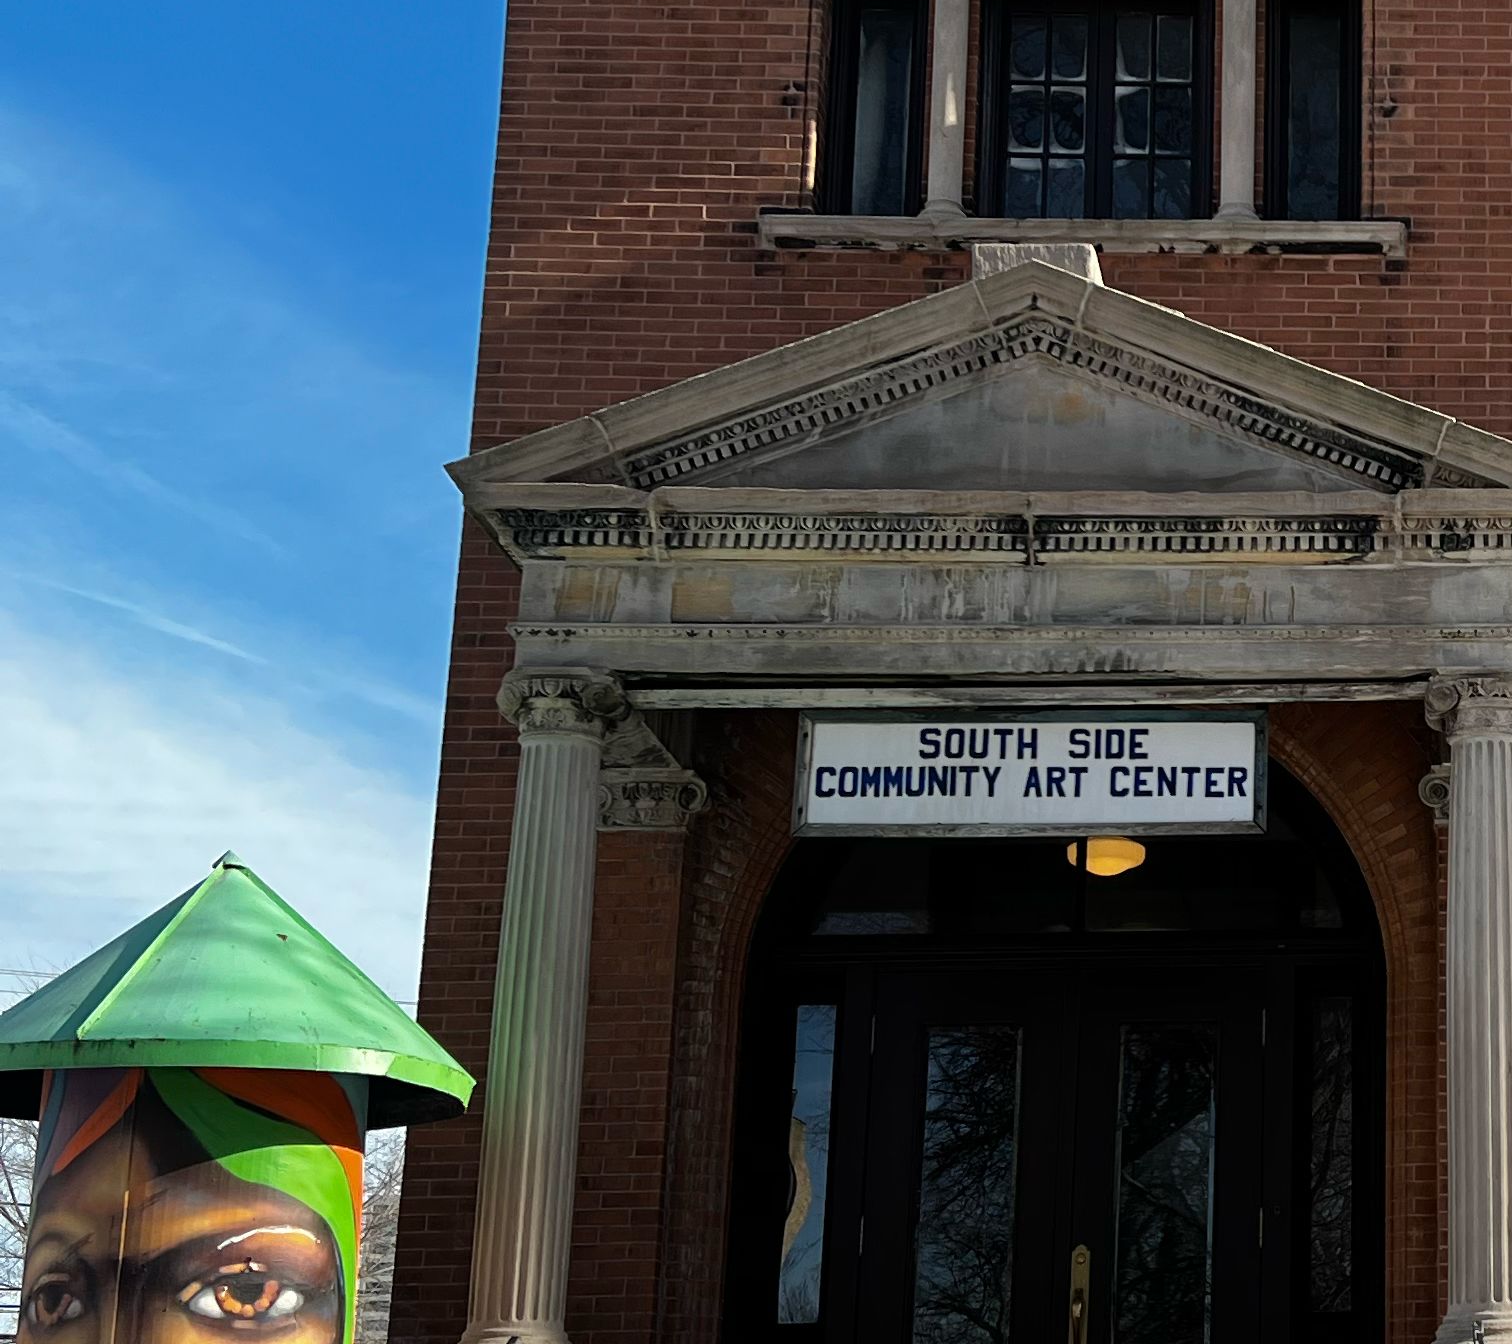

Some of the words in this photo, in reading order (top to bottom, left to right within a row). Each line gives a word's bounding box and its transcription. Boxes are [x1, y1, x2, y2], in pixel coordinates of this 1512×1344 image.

[918, 727, 1039, 760] SOUTH
[1067, 727, 1150, 760] SIDE
[814, 765, 1002, 799] COMMUNITY
[1022, 765, 1090, 799] ART
[1109, 765, 1248, 799] CENTER
